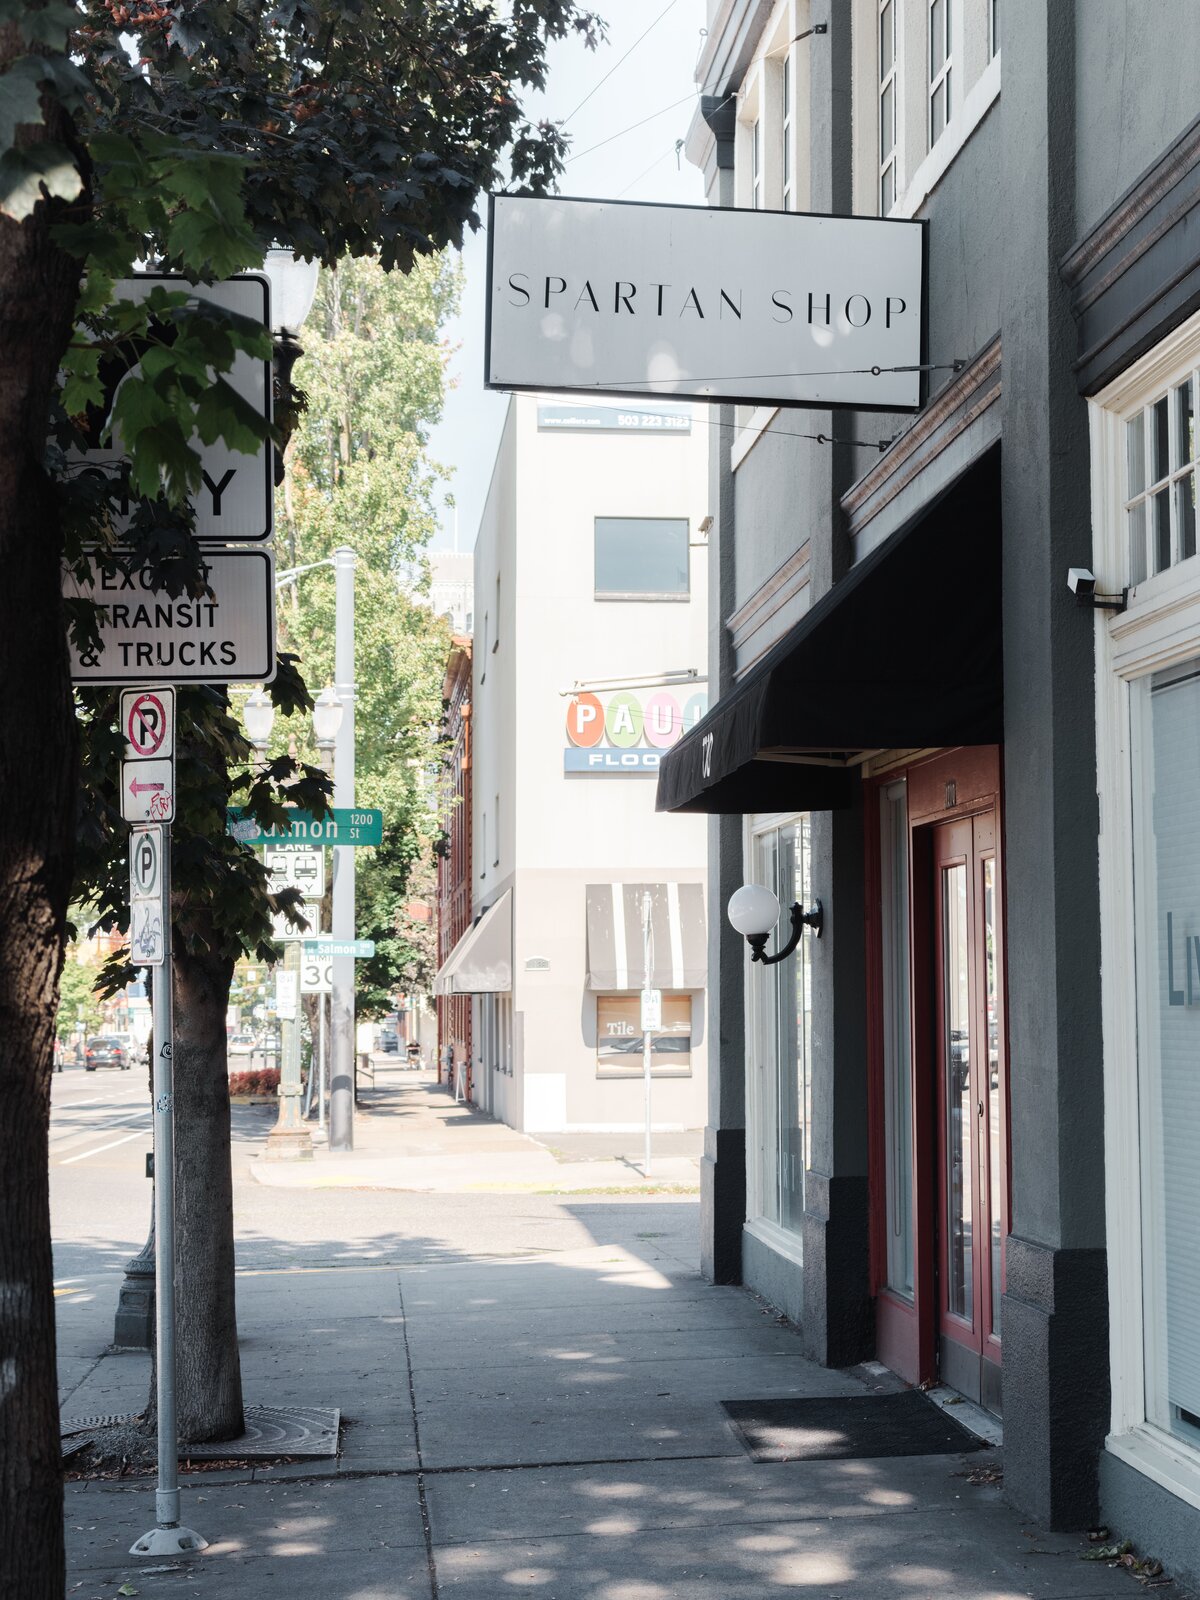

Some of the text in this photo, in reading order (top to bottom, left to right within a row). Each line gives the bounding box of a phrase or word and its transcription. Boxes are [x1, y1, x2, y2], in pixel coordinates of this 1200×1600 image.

[508, 272, 907, 329] SPARTAN SHOP
[618, 414, 639, 426] 503
[641, 415, 662, 427] 223
[97, 603, 219, 629] TRANSIT
[79, 641, 237, 668] & TRUCKS
[350, 813, 373, 826] 1200
[350, 827, 360, 839] St
[275, 843, 314, 852] LANE
[318, 943, 356, 955] Salmon
[606, 1020, 635, 1036] Tile
